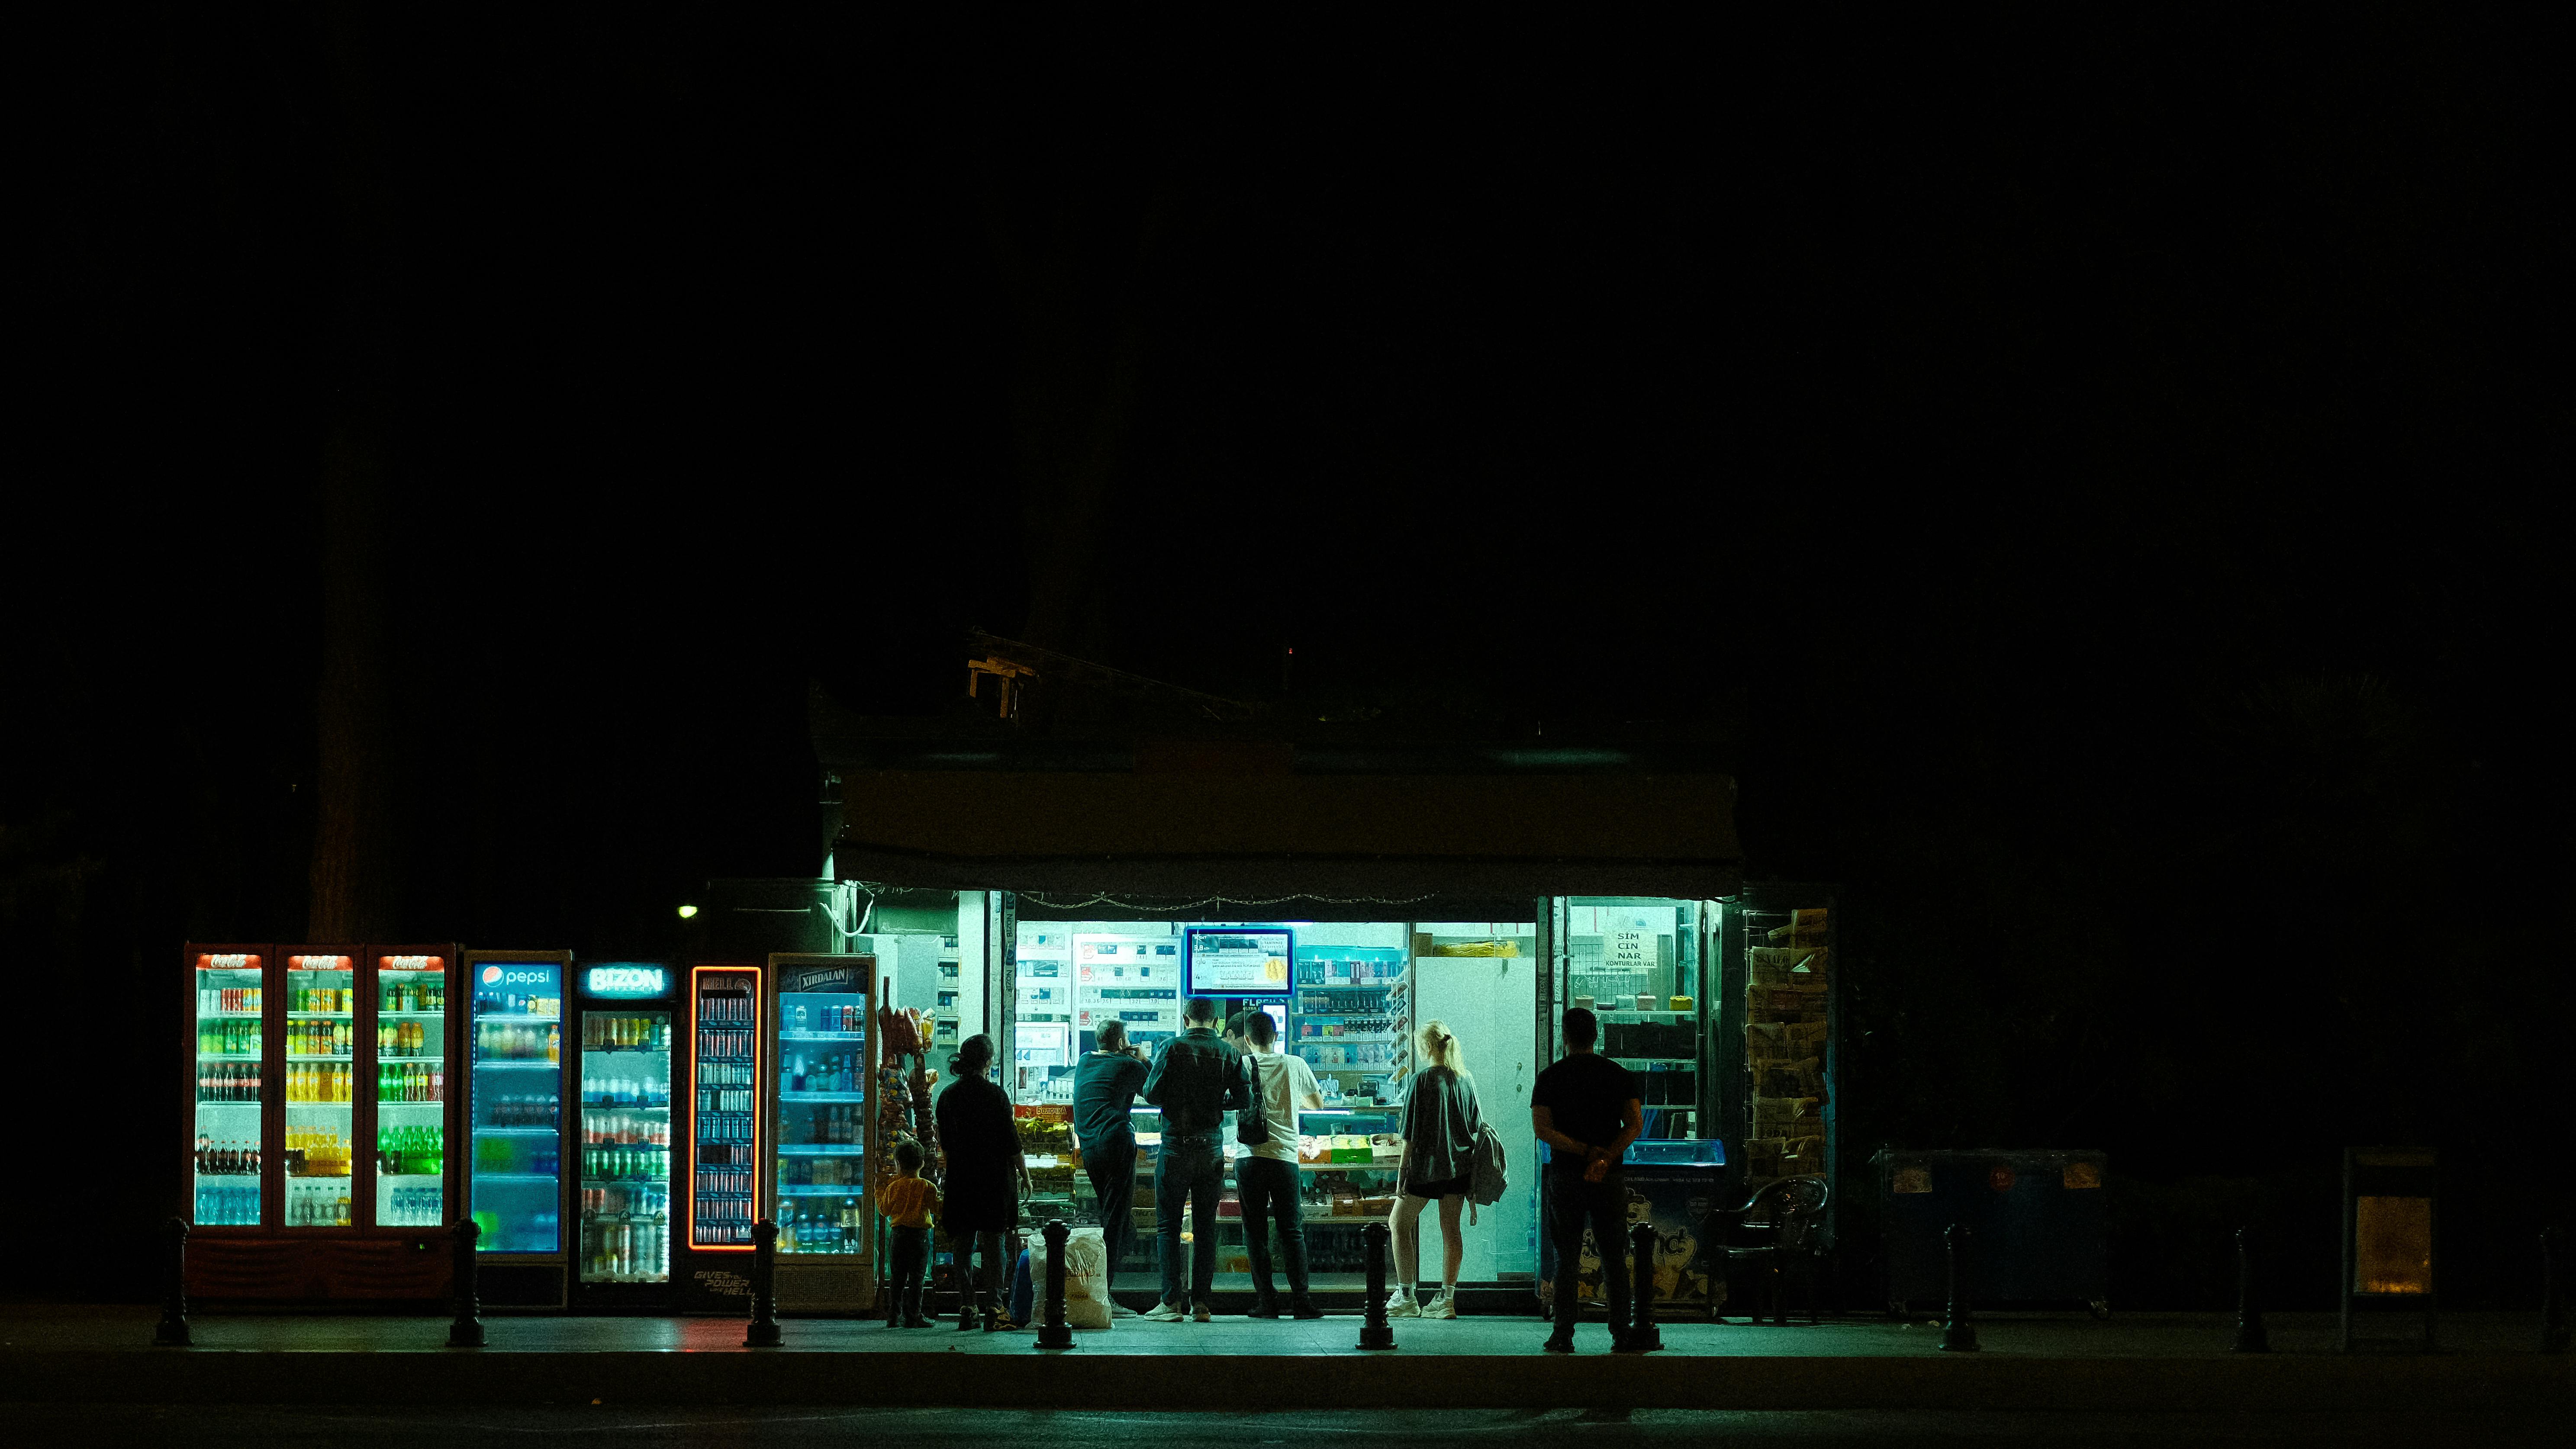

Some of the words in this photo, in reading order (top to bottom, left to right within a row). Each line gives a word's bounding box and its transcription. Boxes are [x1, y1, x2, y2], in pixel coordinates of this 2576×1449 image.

[506, 970, 549, 985] pepsi
[589, 968, 663, 991] BIZON
[703, 977, 733, 990] HELL
[802, 969, 845, 989] XIRDALAN
